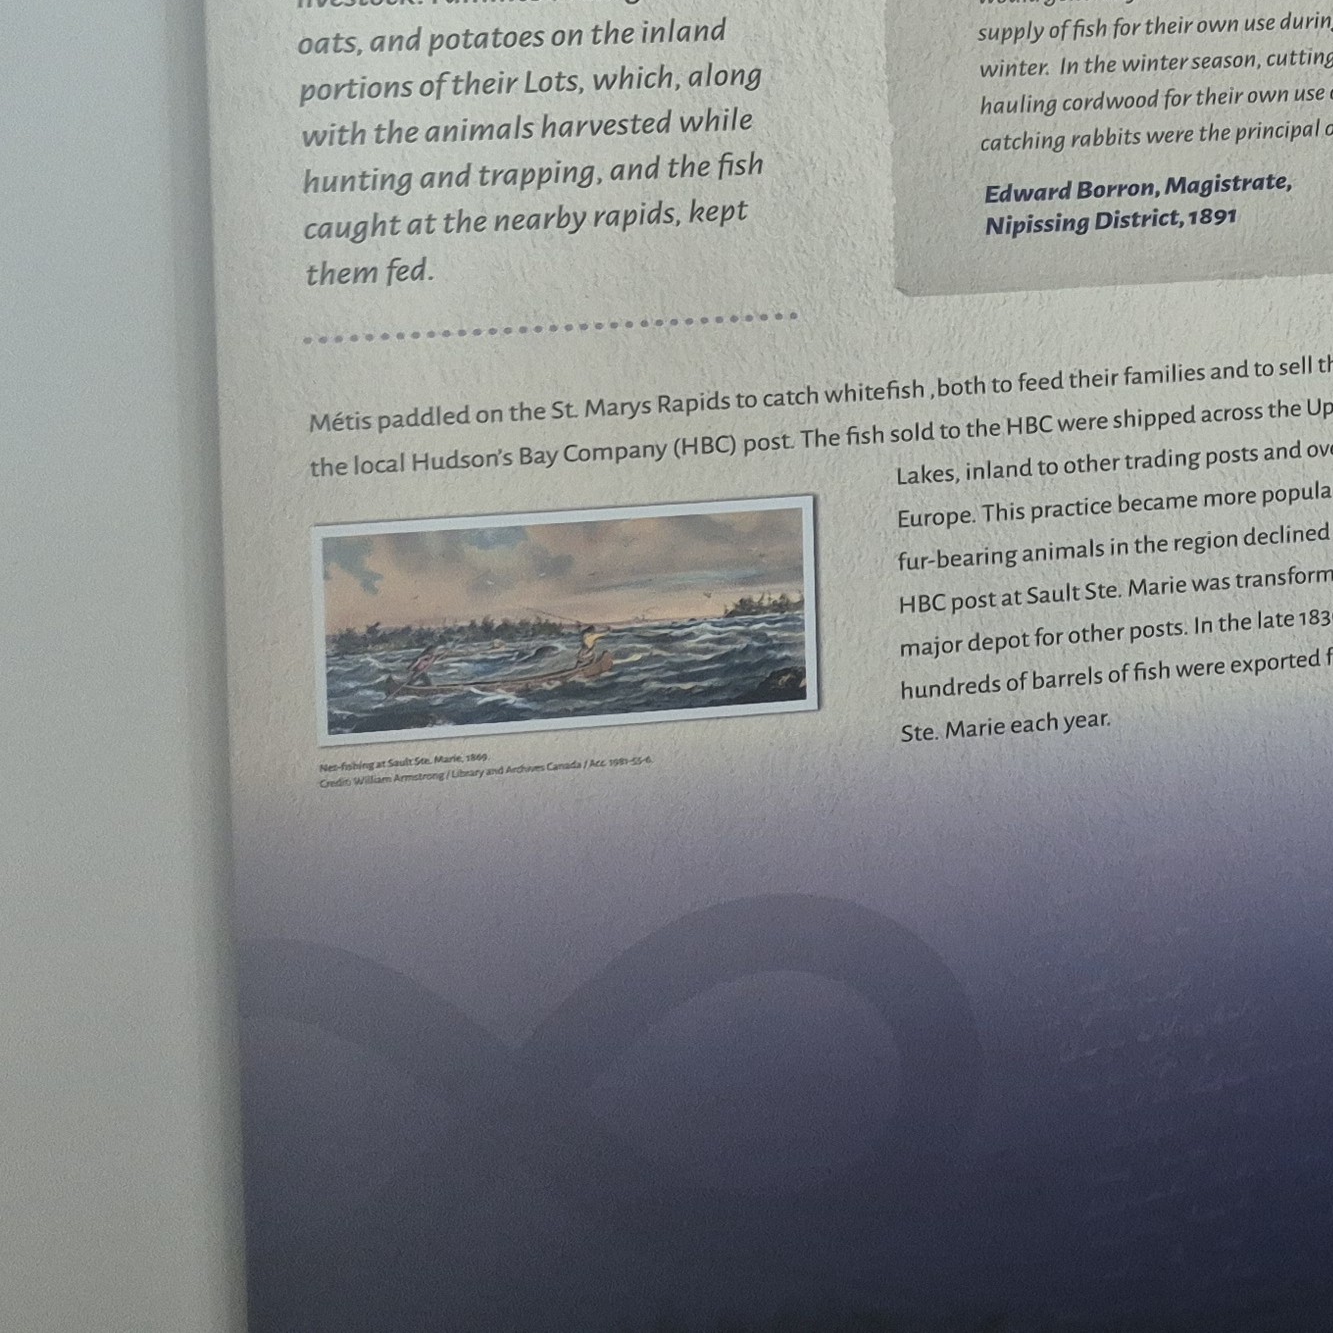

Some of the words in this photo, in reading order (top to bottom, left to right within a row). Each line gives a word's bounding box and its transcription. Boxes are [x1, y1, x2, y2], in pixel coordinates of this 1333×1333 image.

[302, 167, 413, 196] hunting
[419, 162, 472, 189] and
[478, 159, 602, 191] trapping,
[609, 154, 660, 180] and
[667, 153, 710, 178] the
[717, 150, 763, 180] fish
[984, 179, 1072, 203] Edward
[1076, 180, 1160, 199] Borron,
[1164, 173, 1292, 198] Magistrate,
[985, 212, 1089, 239] Nipissing
[1094, 207, 1184, 230] District,
[1188, 207, 1236, 225] 1891
[310, 456, 347, 477] the
[354, 452, 404, 475] local
[412, 448, 512, 471] Hudson's
[519, 446, 558, 468] Bay
[563, 443, 667, 464] Company
[673, 434, 736, 459] (HBC)
[743, 433, 794, 457] post.
[799, 427, 840, 448] The
[845, 424, 884, 445] fish
[890, 420, 934, 443] sold
[939, 423, 960, 439] to
[965, 417, 1000, 437] the
[1006, 414, 1053, 435] HBC
[1057, 415, 1108, 432] were
[1112, 404, 1196, 431] shipped
[1201, 405, 1263, 423] across
[1267, 398, 1301, 418] the
[900, 635, 963, 659] major
[967, 631, 1029, 654] depot
[1034, 626, 1063, 646] for
[1068, 622, 1124, 644] other
[1129, 620, 1187, 644] posts.
[1194, 616, 1212, 634] In
[1217, 612, 1251, 632] the
[1257, 610, 1294, 629] late
